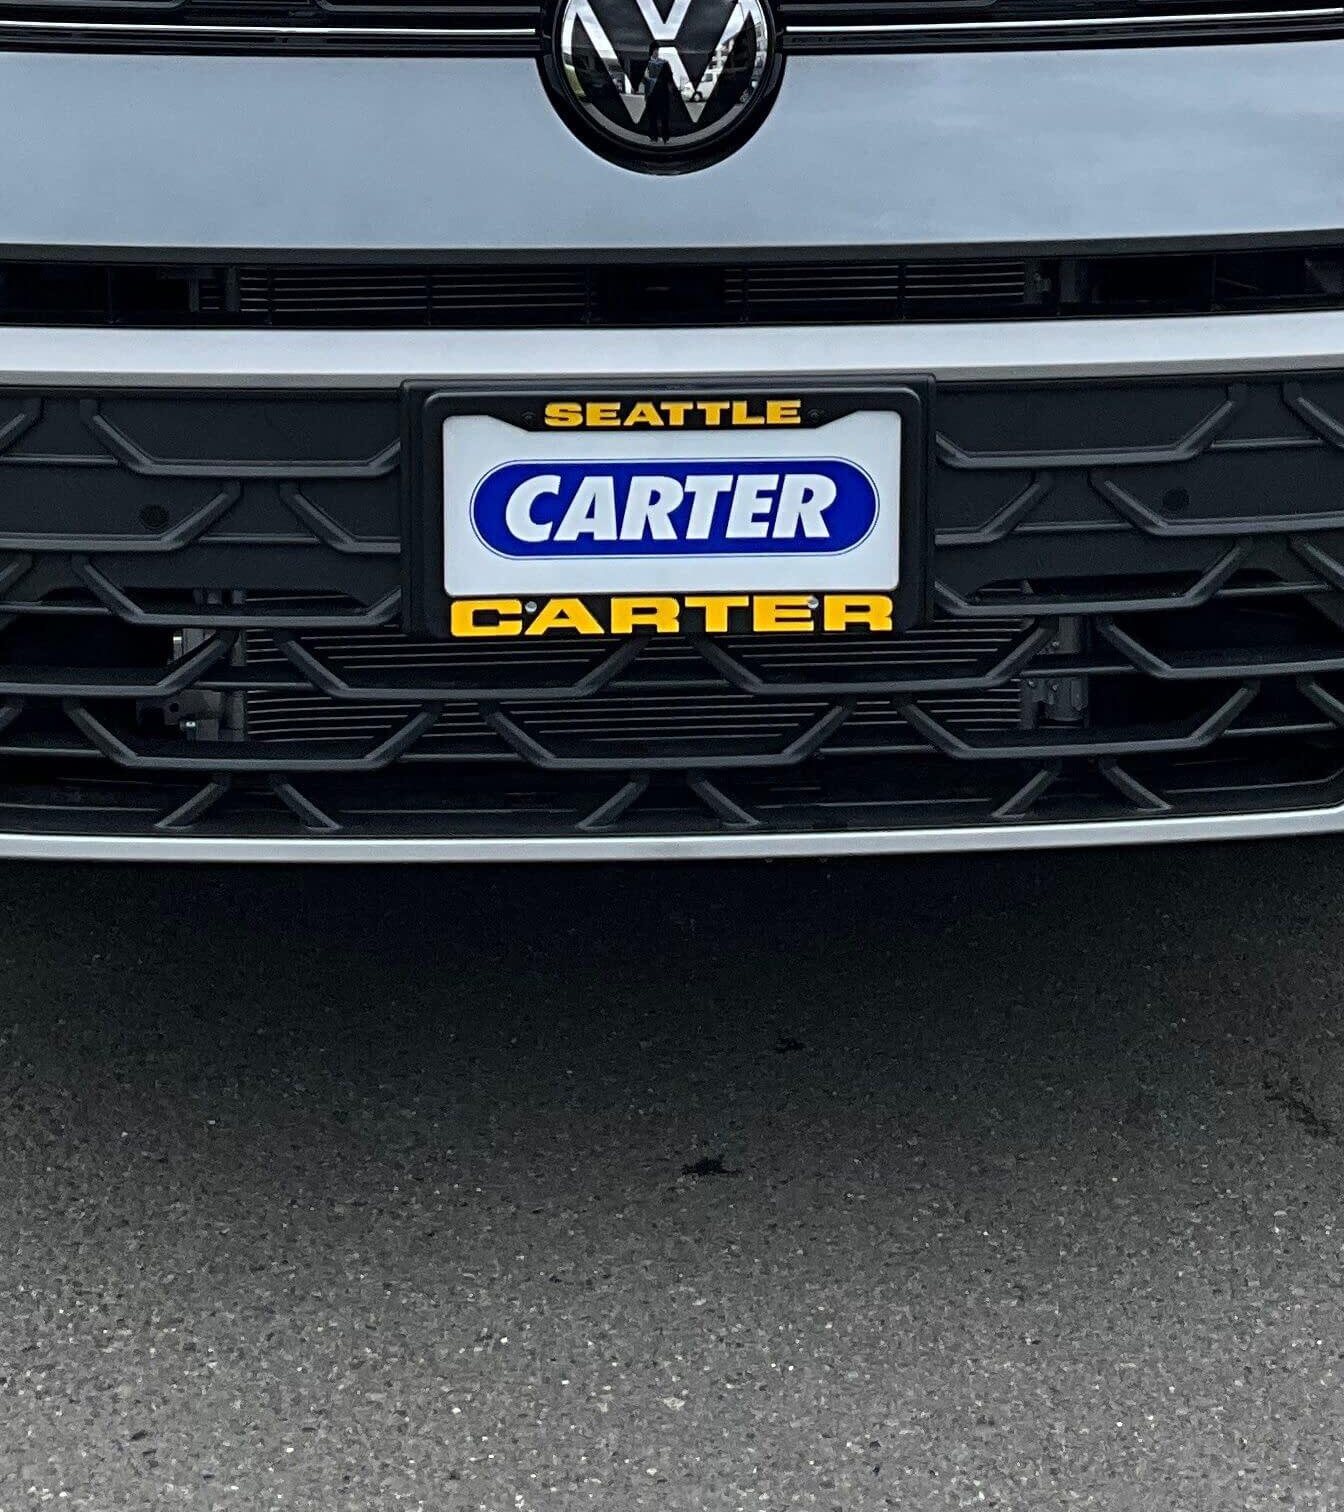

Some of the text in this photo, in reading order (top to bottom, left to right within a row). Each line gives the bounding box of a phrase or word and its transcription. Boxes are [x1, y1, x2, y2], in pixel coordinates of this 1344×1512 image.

[544, 399, 802, 427] SEATTLE
[504, 473, 837, 542] CARTER
[450, 594, 894, 637] CARTER
